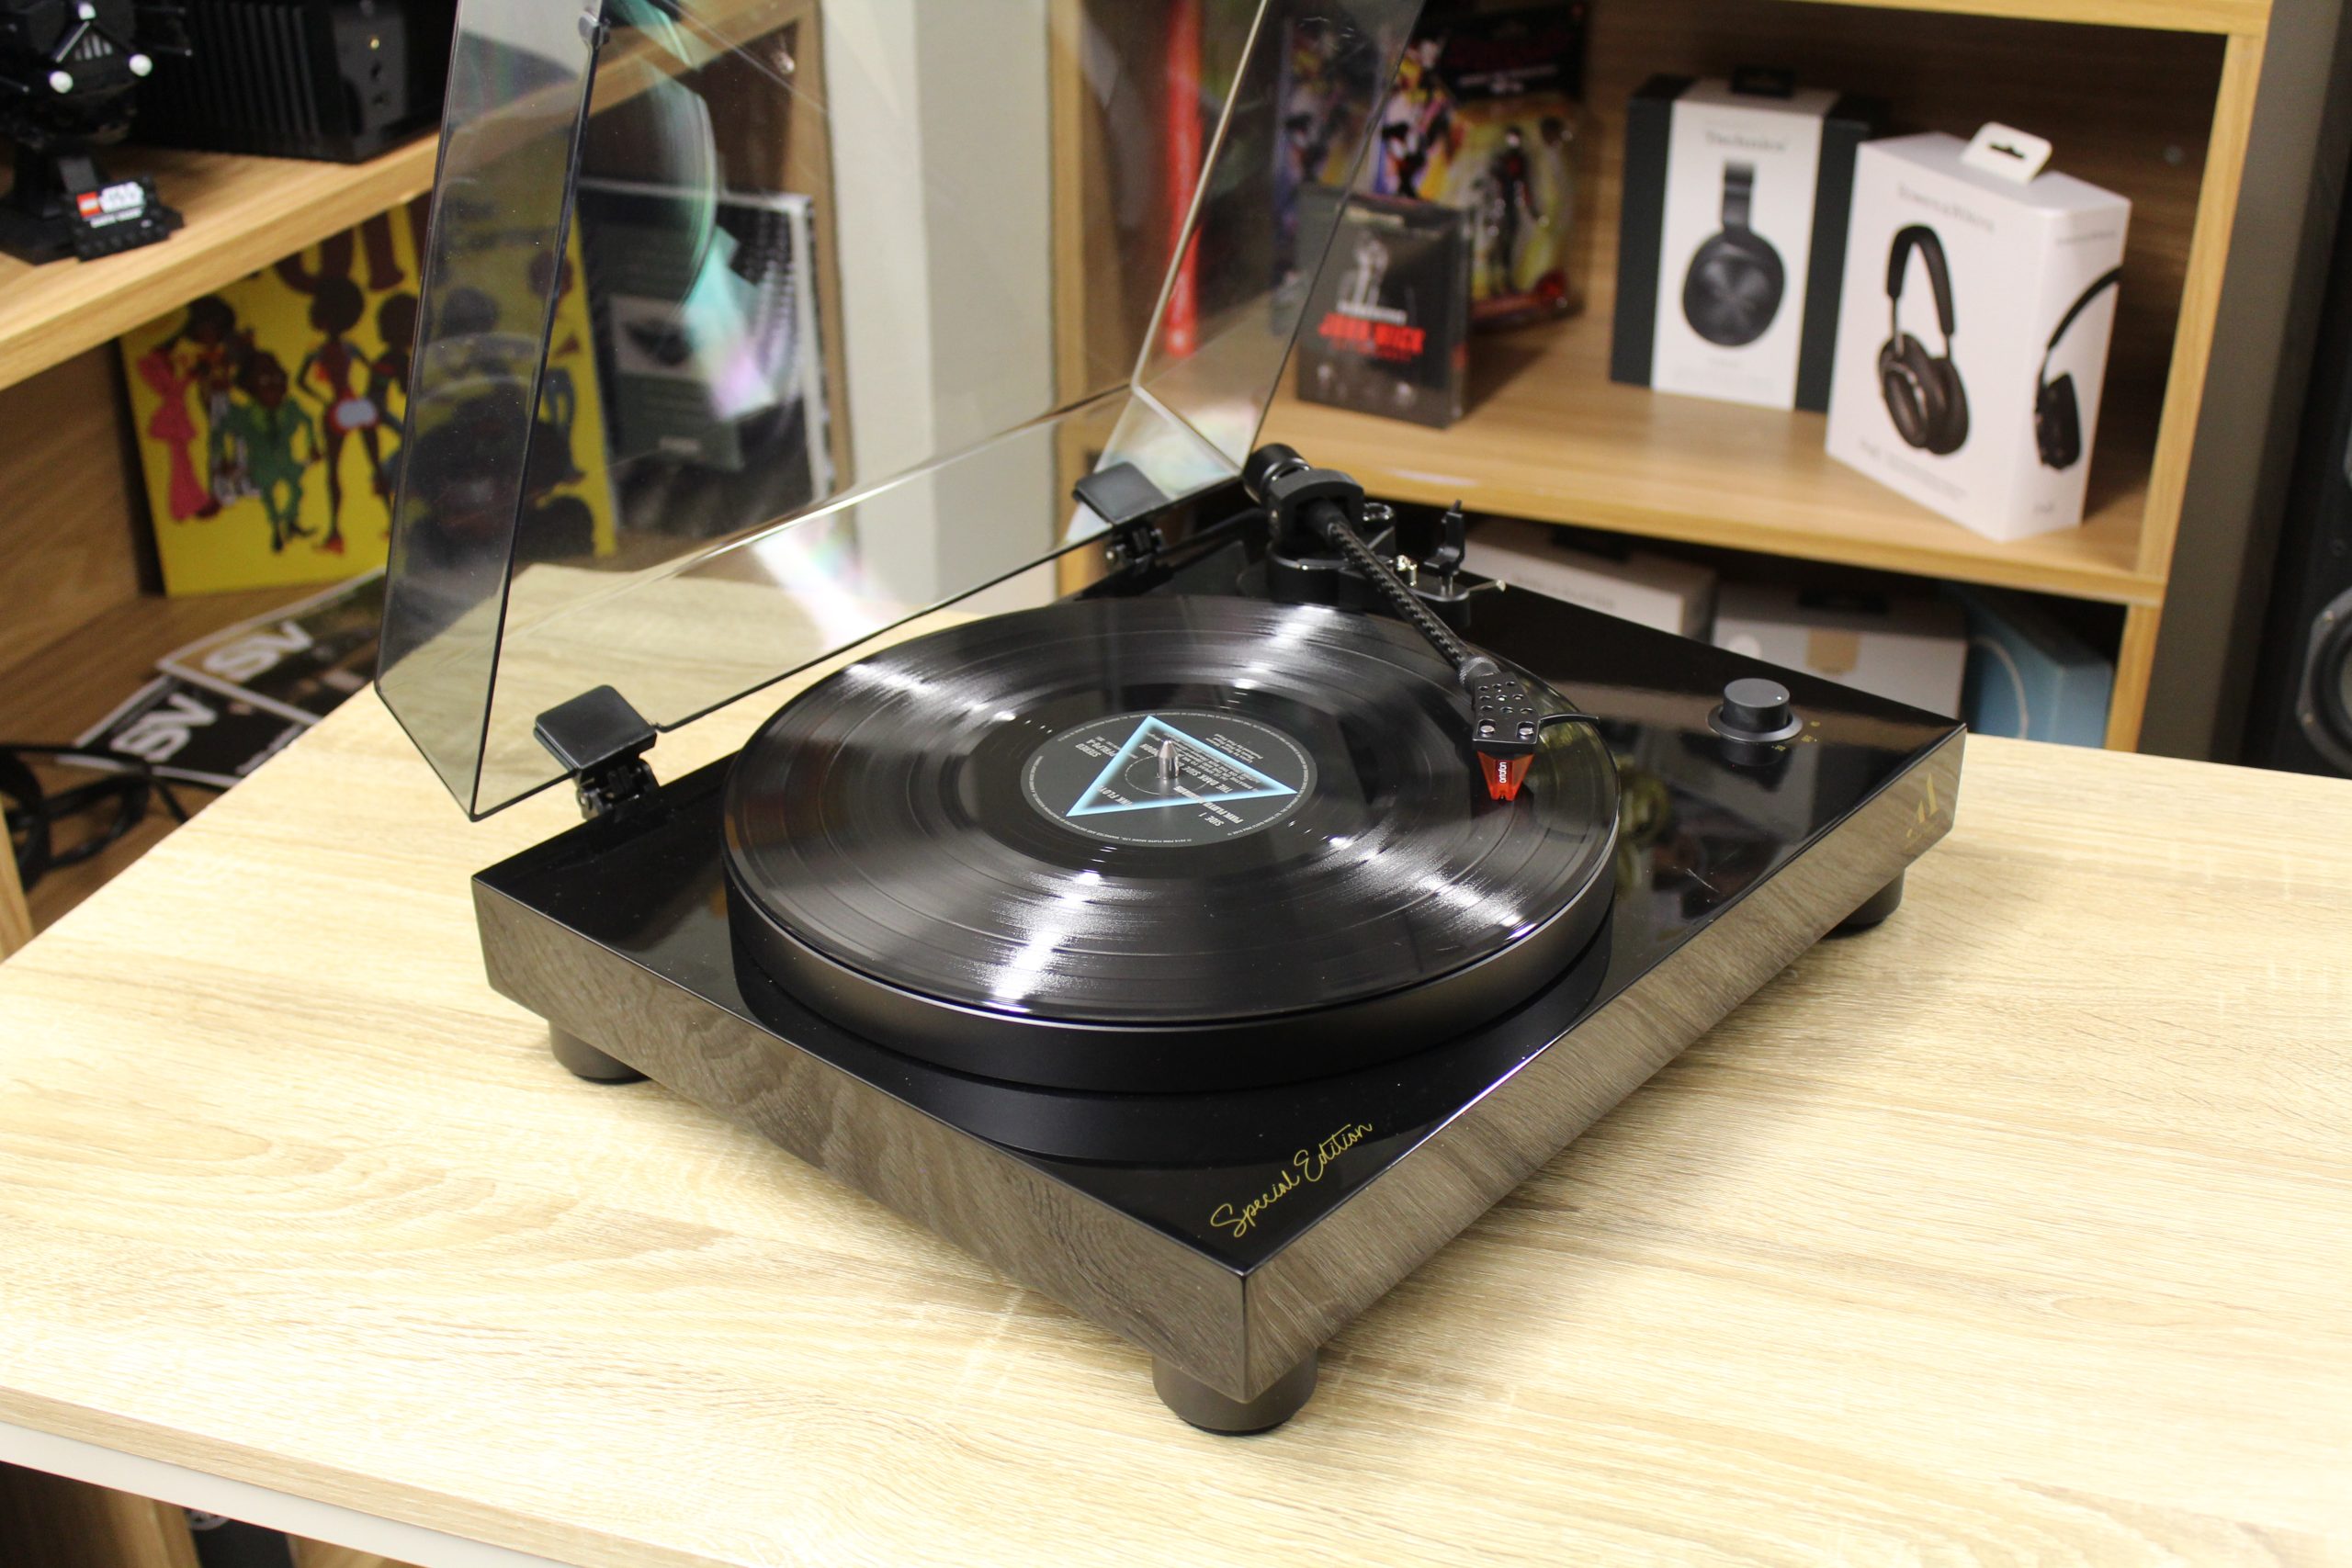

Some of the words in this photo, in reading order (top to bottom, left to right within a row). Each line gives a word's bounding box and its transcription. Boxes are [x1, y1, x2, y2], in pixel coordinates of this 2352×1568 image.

[109, 693, 219, 762] SV
[1075, 743, 1102, 757] STEREO
[1182, 765, 1201, 776] SIDE
[1499, 762, 1507, 783] ortofon
[1197, 774, 1219, 786] DARK
[1216, 784, 1233, 793] THE
[1204, 815, 1225, 826] SIDE
[1210, 1170, 1300, 1238] Special
[1294, 1123, 1373, 1182] Edition
